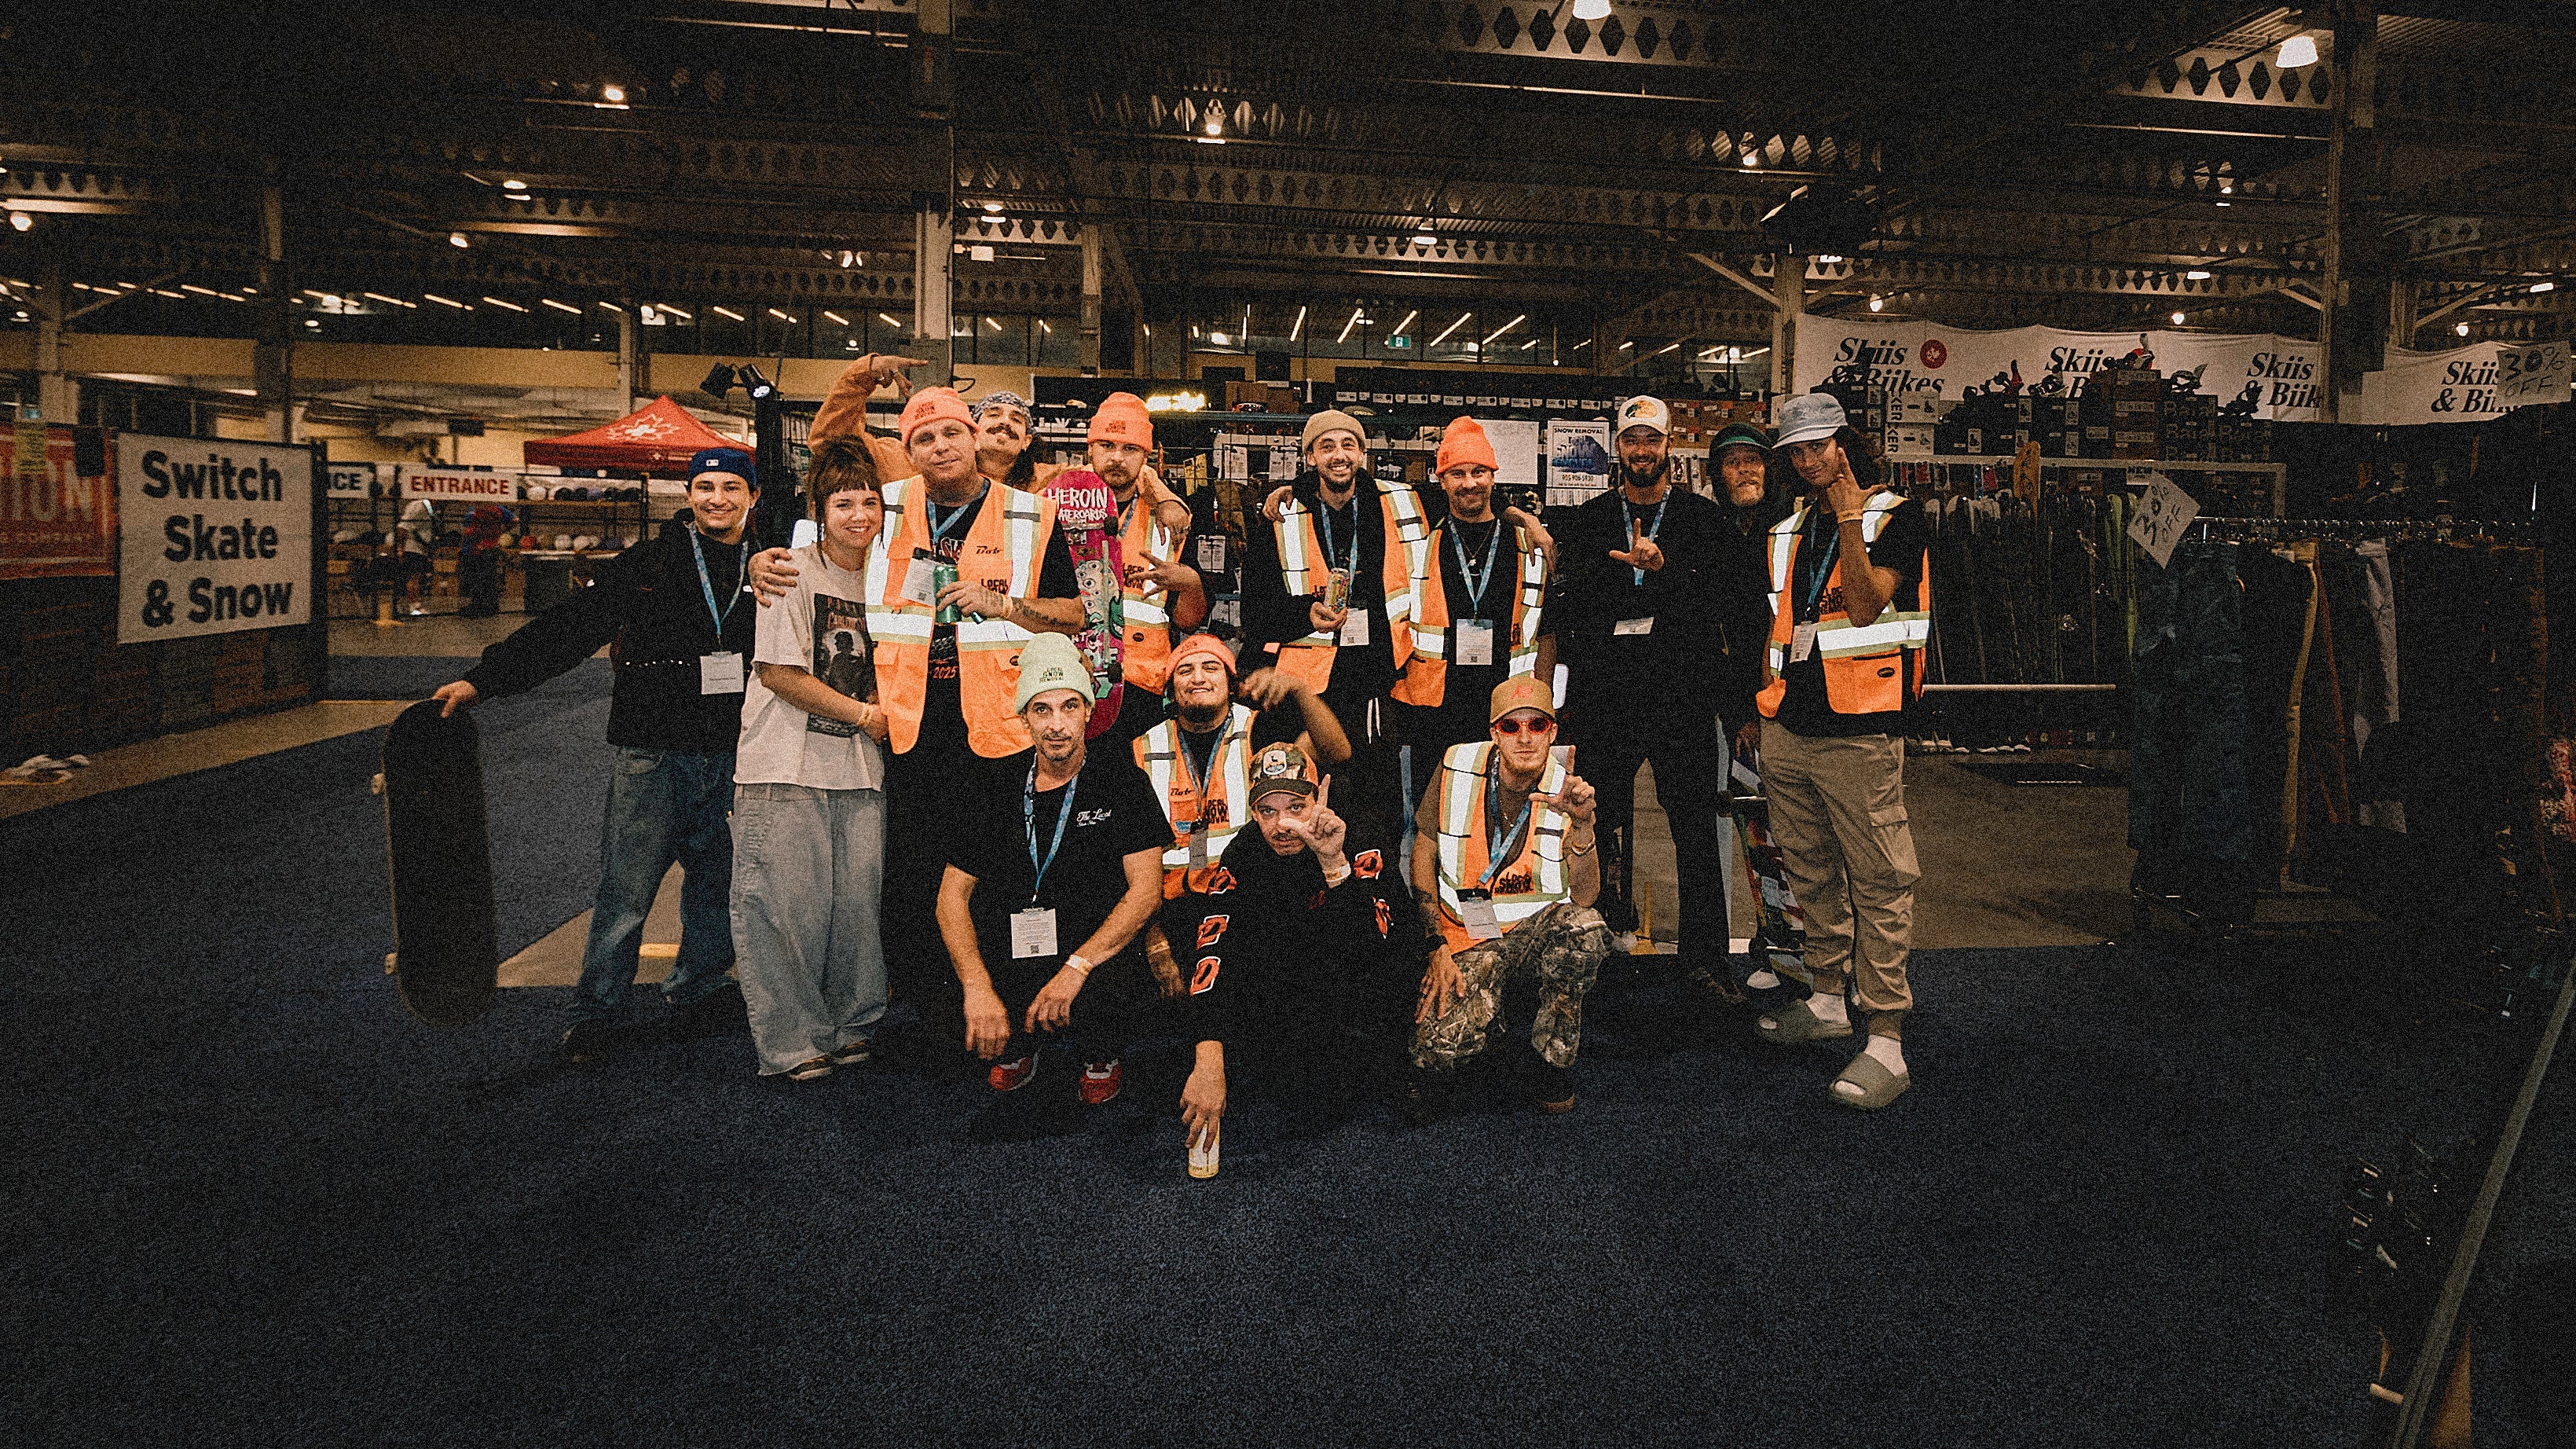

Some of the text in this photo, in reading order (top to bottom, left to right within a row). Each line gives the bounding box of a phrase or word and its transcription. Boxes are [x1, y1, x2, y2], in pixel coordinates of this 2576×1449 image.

[2247, 352, 2314, 380] Skiis
[2505, 346, 2567, 381] 30%
[2505, 375, 2552, 398] OFF
[2431, 388, 2457, 413] &
[142, 450, 282, 501] Switch
[411, 475, 510, 495] ENTRANCE
[0, 456, 93, 523] ION
[1047, 486, 1108, 510] HEROIN
[1057, 508, 1108, 522] ATEBOARDS
[164, 514, 278, 563] Skate
[141, 577, 293, 628] & Snow
[933, 666, 958, 680] 2025
[1076, 808, 1112, 823] The Local
